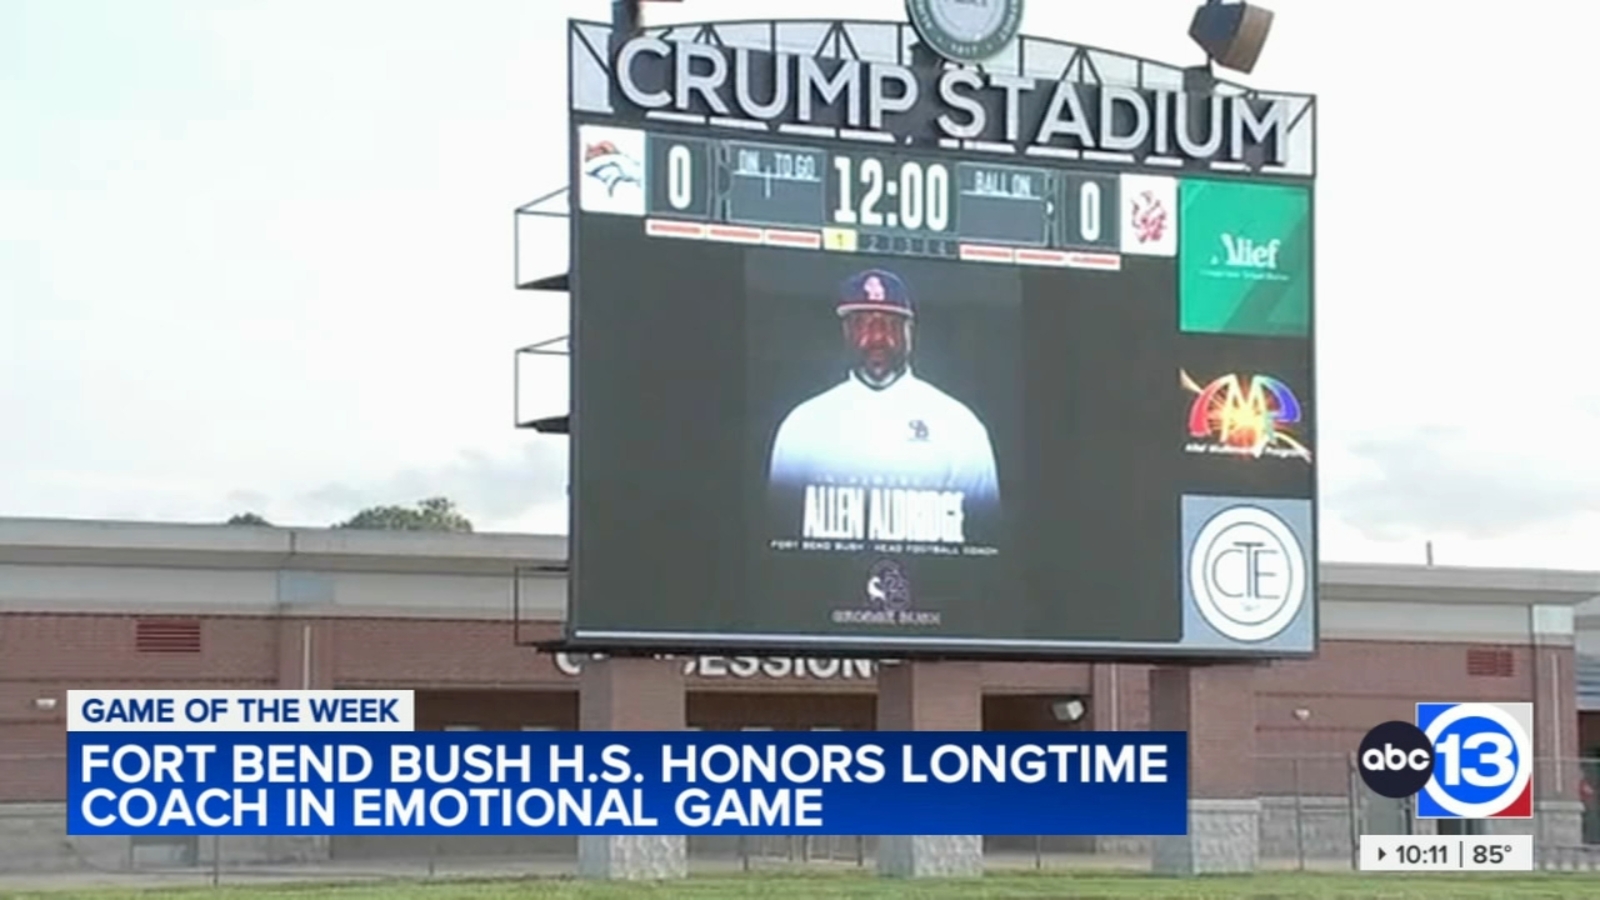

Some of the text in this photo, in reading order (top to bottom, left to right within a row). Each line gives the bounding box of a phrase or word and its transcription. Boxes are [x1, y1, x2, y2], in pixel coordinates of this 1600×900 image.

[616, 37, 1286, 165] CRUMP STADIUM
[667, 145, 692, 210] 0
[833, 155, 949, 232] 12:00
[974, 169, 1032, 197] BALL ON
[1079, 181, 1101, 242] 0
[803, 485, 865, 540] ALLEN
[1212, 541, 1281, 600] CTE
